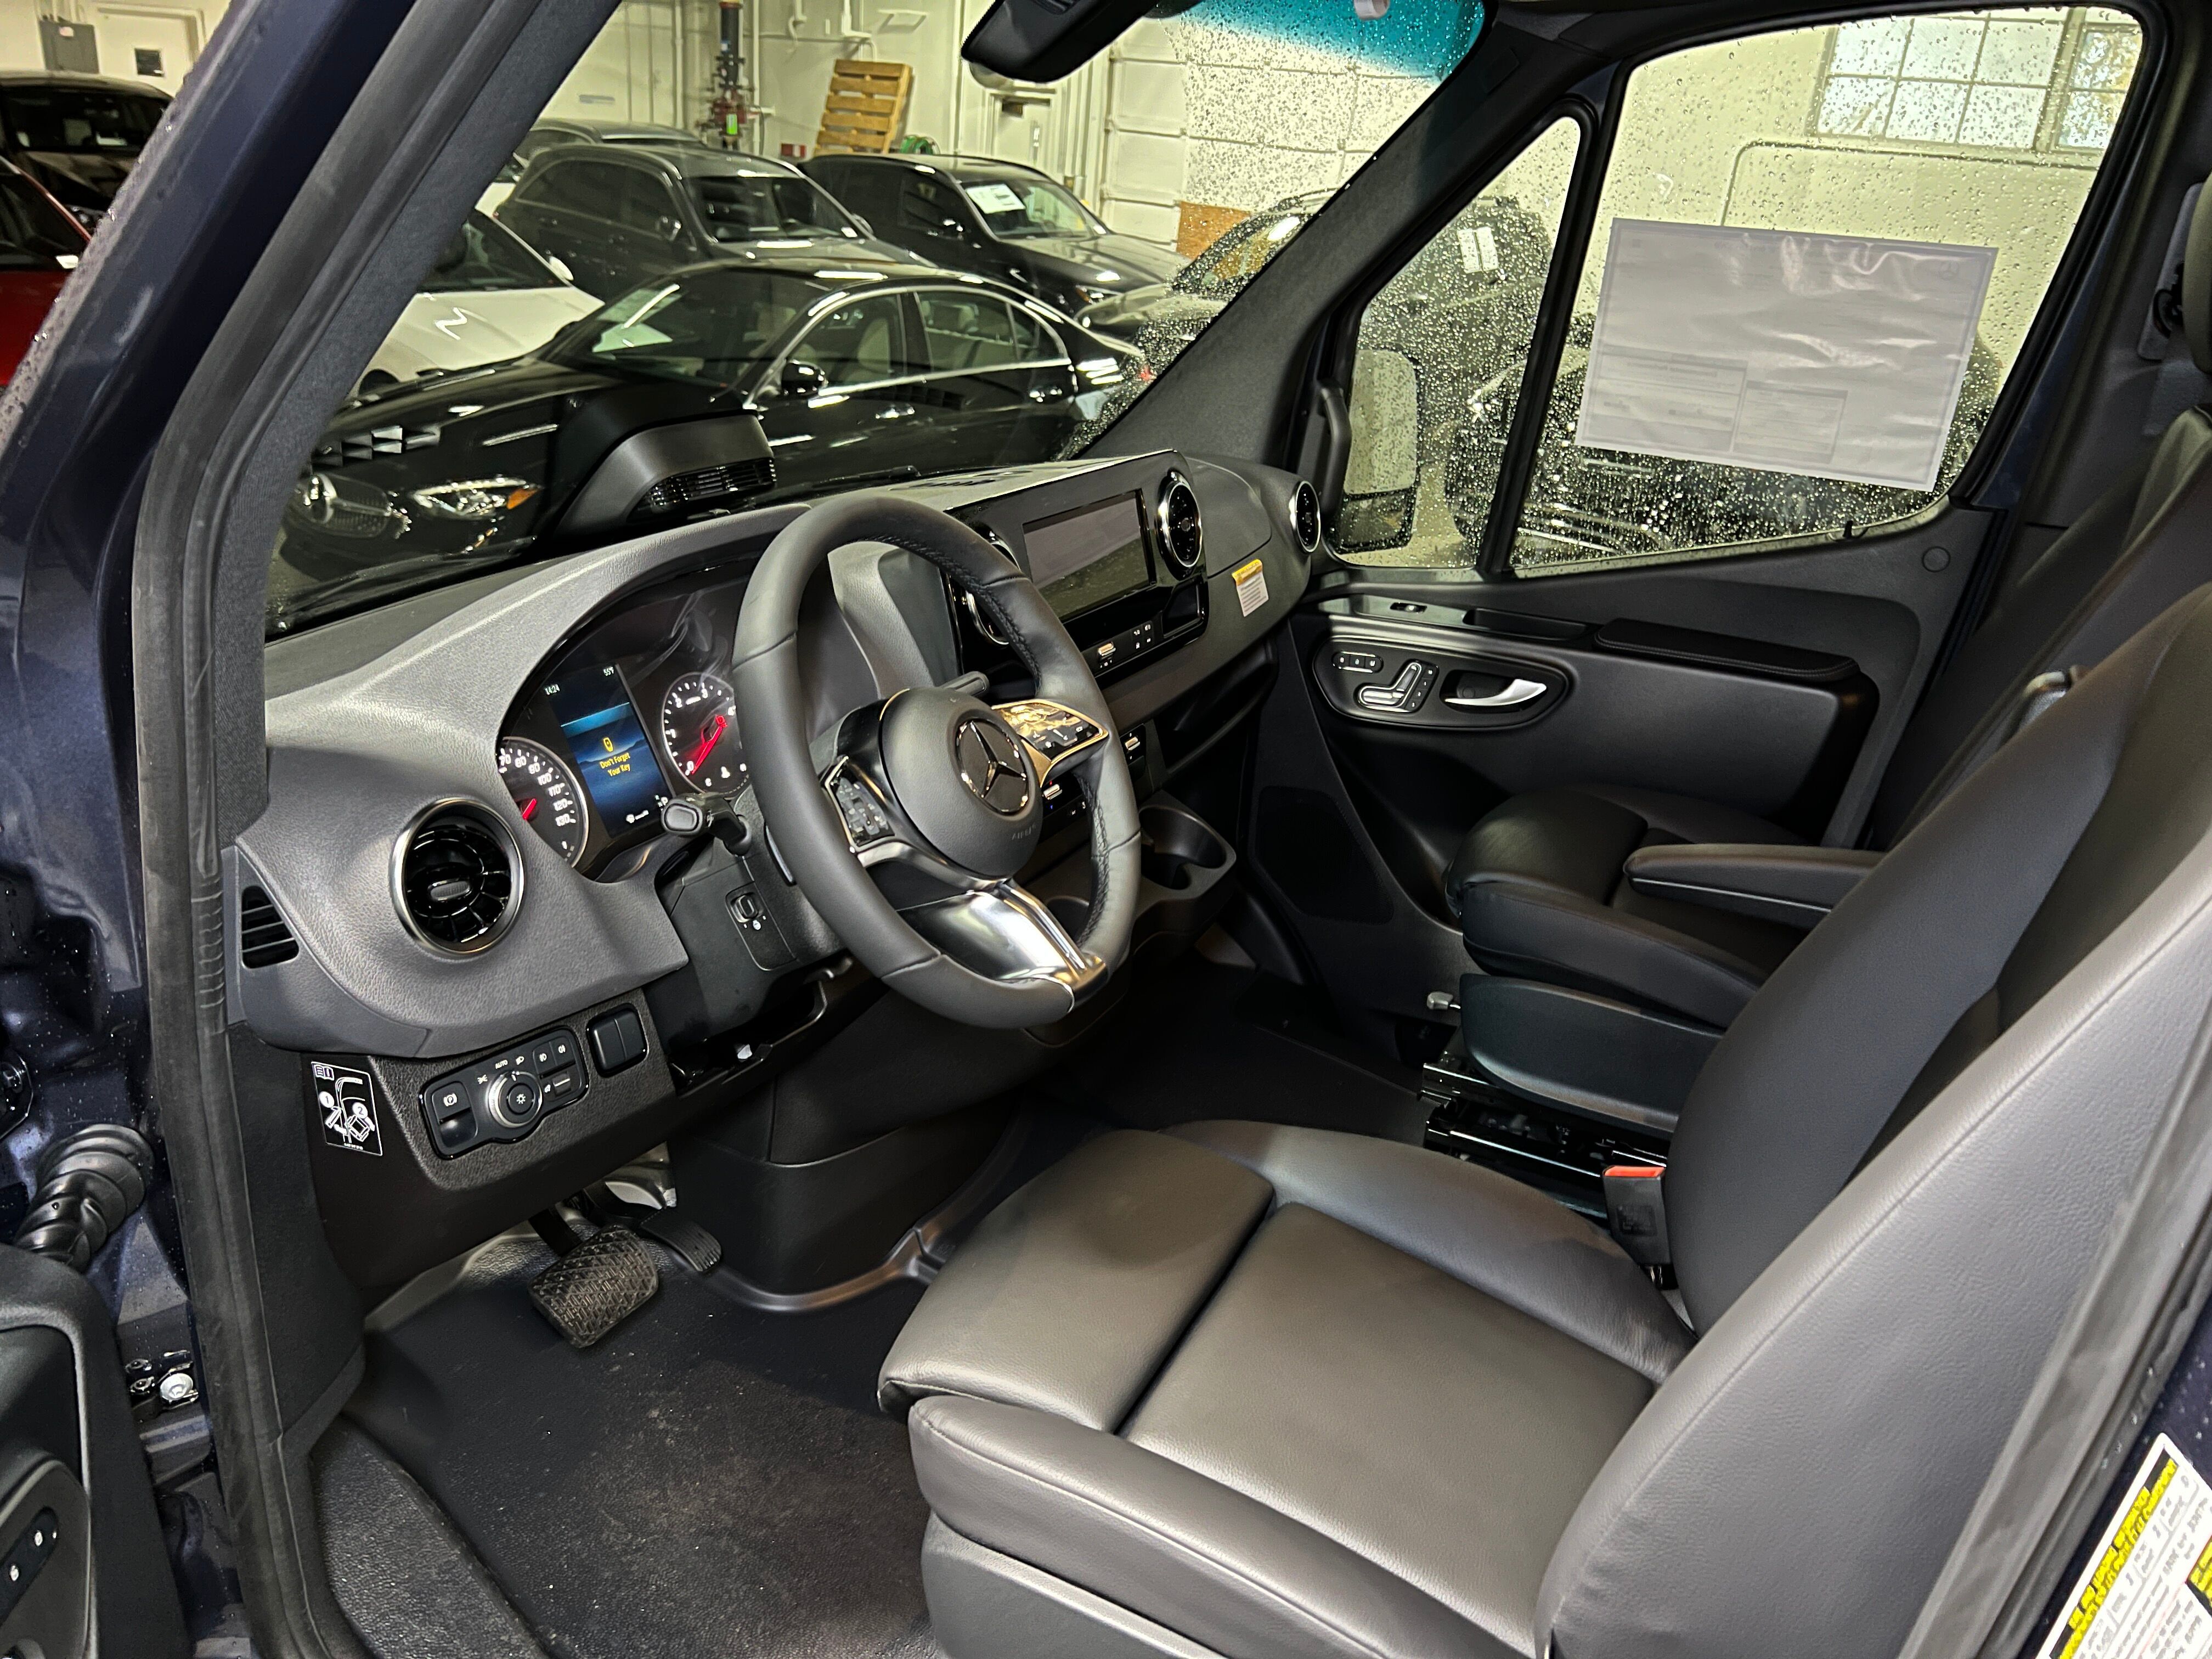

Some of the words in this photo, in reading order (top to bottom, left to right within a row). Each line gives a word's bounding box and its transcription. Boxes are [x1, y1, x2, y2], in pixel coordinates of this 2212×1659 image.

[675, 697, 683, 708] 2
[600, 758, 614, 769] Don't
[614, 752, 631, 764] Forget
[607, 768, 620, 777] Your
[620, 764, 631, 772] Key
[537, 772, 552, 786] 100
[548, 783, 561, 797] 110
[554, 798, 568, 811] 120
[495, 1059, 509, 1069] AUTO
[325, 1096, 329, 1104] 1
[358, 1106, 364, 1115] 2
